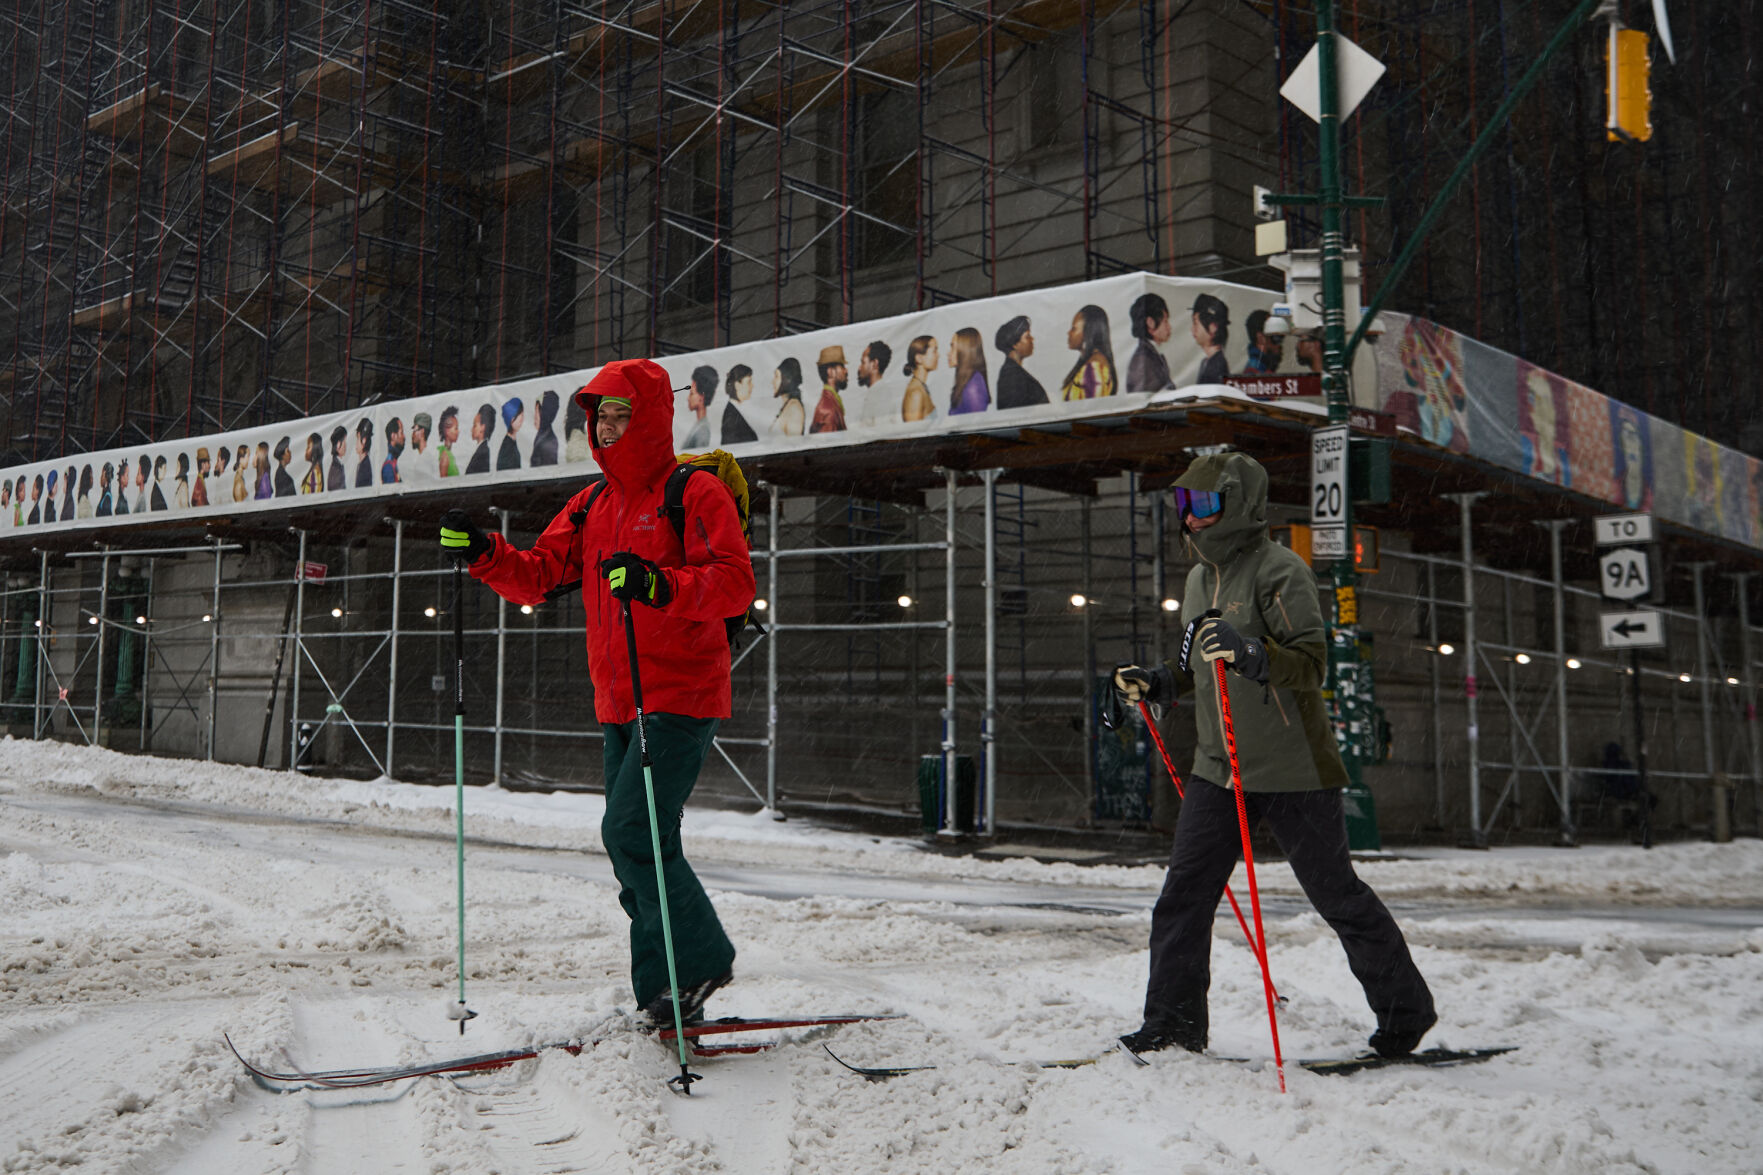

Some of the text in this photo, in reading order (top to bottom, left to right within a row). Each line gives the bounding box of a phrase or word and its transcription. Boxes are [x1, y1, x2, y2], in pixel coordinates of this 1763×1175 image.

[1285, 378, 1299, 395] St
[1314, 436, 1343, 454] SPEED
[1316, 456, 1340, 474] LIMIT
[1315, 482, 1341, 517] 20
[1609, 520, 1638, 537] TO
[1606, 560, 1645, 588] 9A
